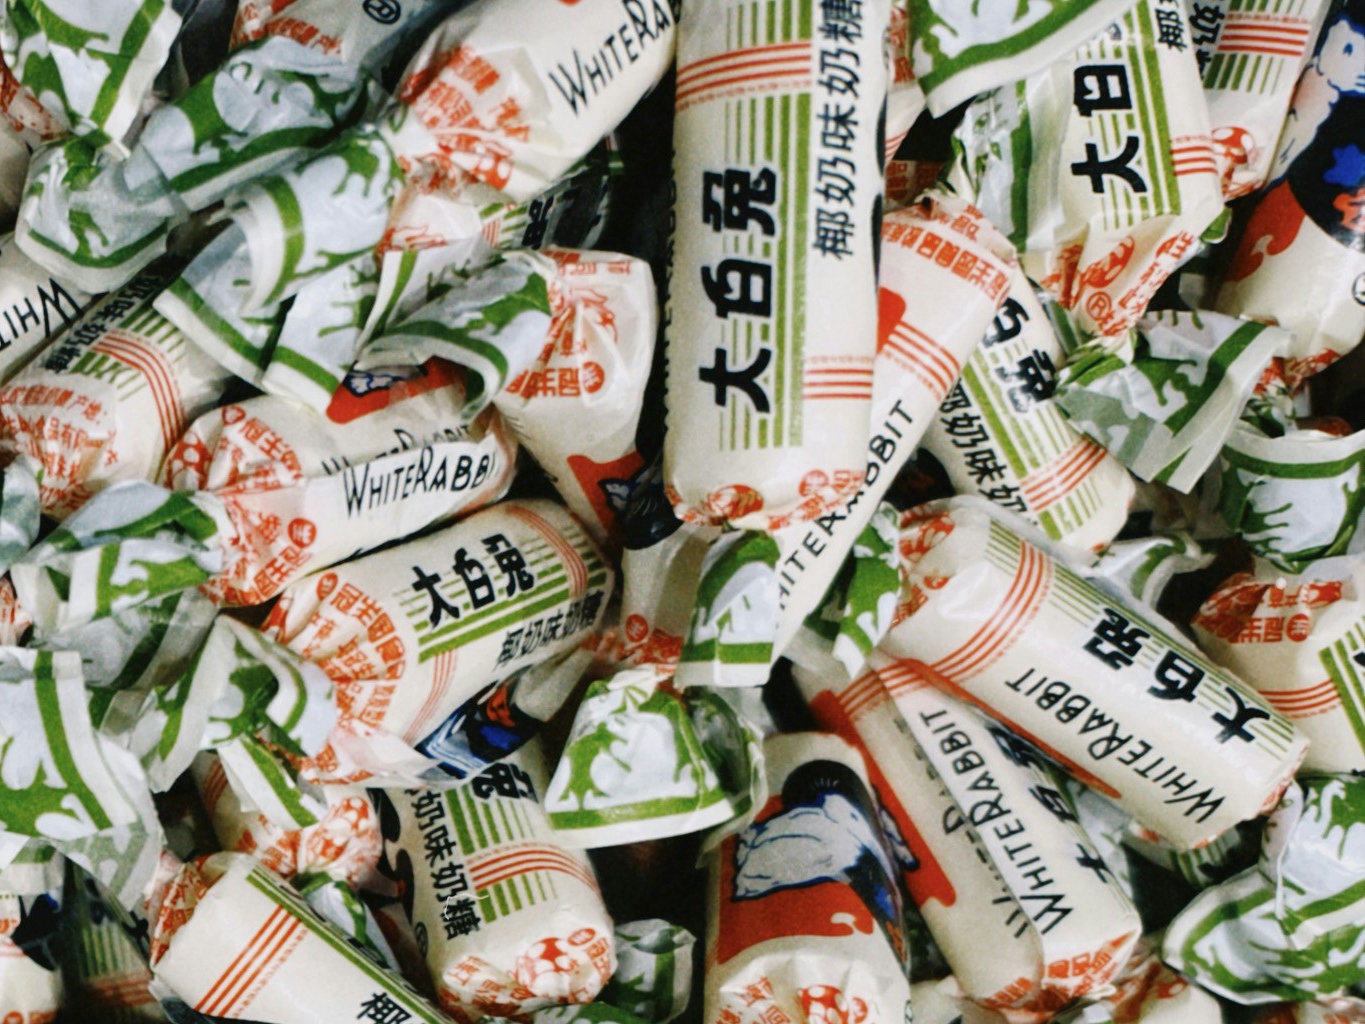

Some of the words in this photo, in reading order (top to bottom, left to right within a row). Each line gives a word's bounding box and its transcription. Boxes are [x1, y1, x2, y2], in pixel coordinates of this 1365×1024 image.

[699, 165, 776, 414] 大白兔
[412, 532, 536, 628] 大白兔
[1006, 666, 1225, 826] WHITERABBIT
[1083, 607, 1270, 742] 大白兔
[920, 708, 1073, 936] WHITERABBIT
